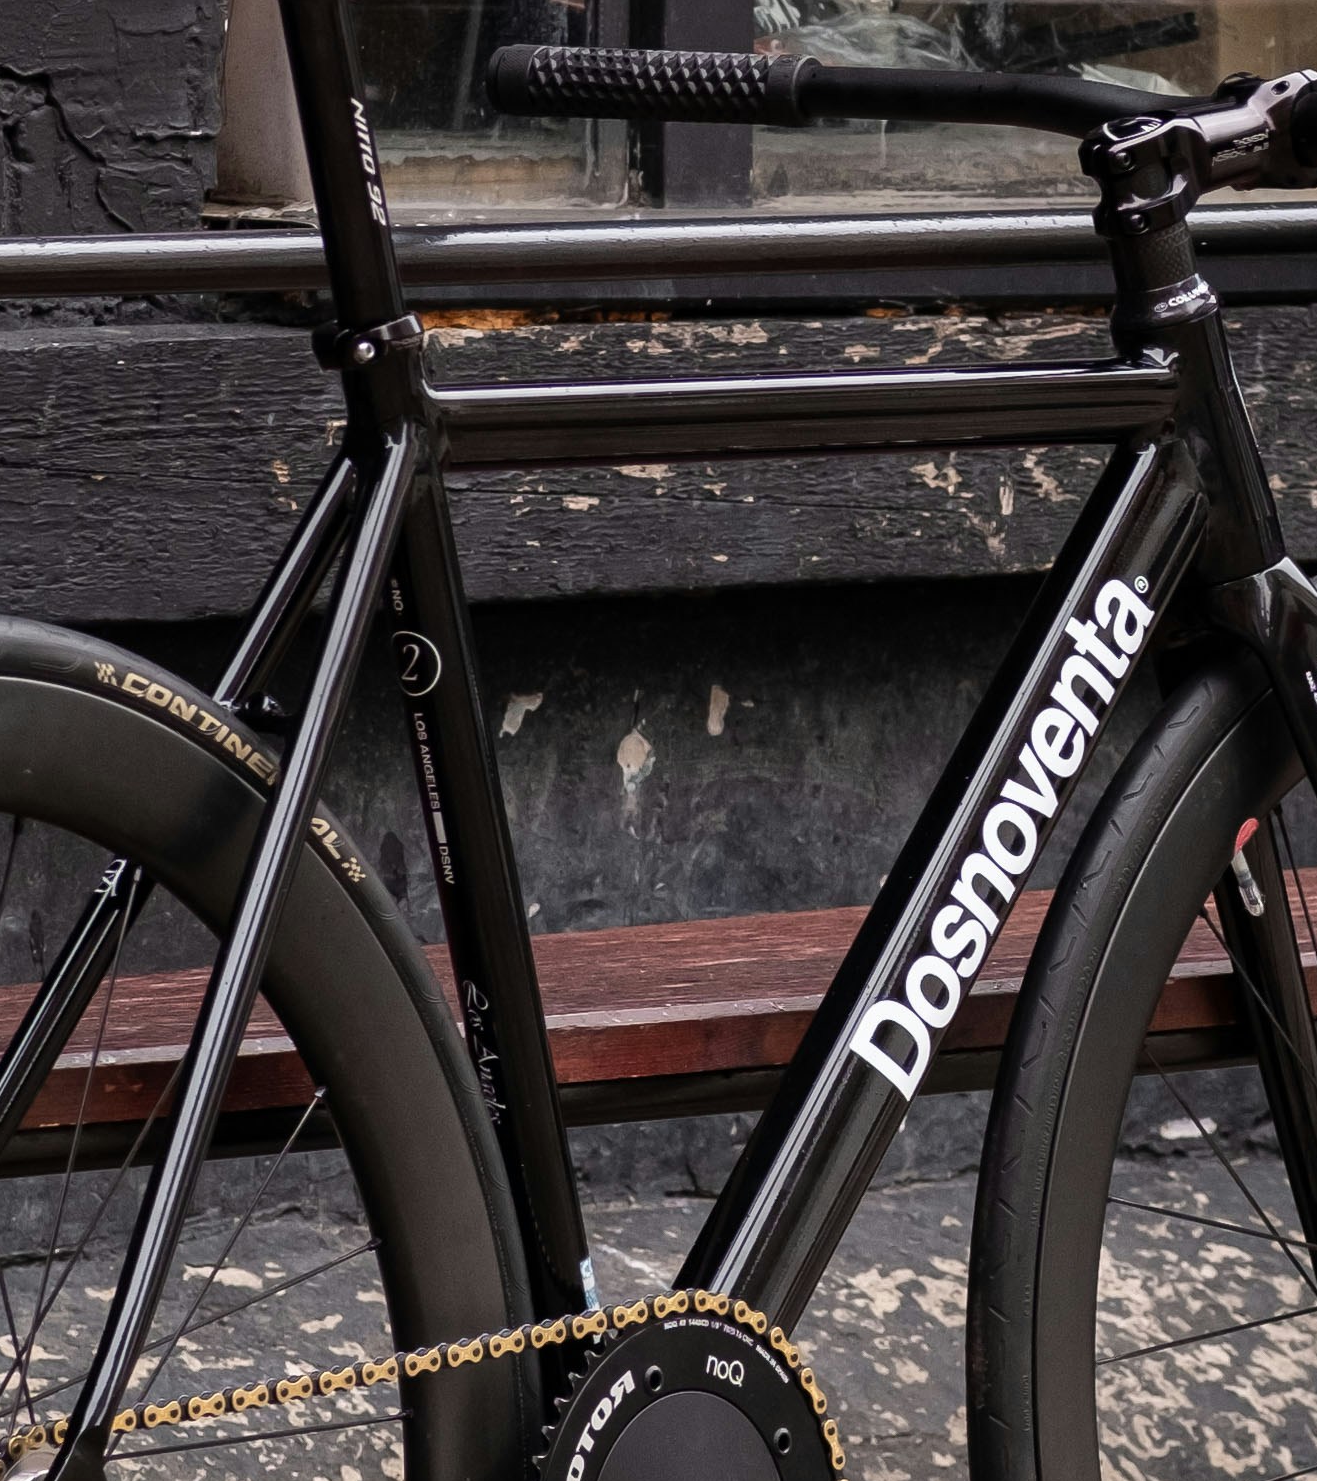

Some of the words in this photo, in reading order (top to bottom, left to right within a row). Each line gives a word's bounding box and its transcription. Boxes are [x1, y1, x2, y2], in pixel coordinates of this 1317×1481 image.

[350, 98, 376, 173] NITTO
[401, 643, 420, 681] 2
[414, 712, 428, 740] LOS
[121, 672, 342, 860] CONTINEAL
[419, 744, 442, 810] ANGELES
[438, 846, 455, 885] DSNV
[706, 1354, 744, 1387] noQ
